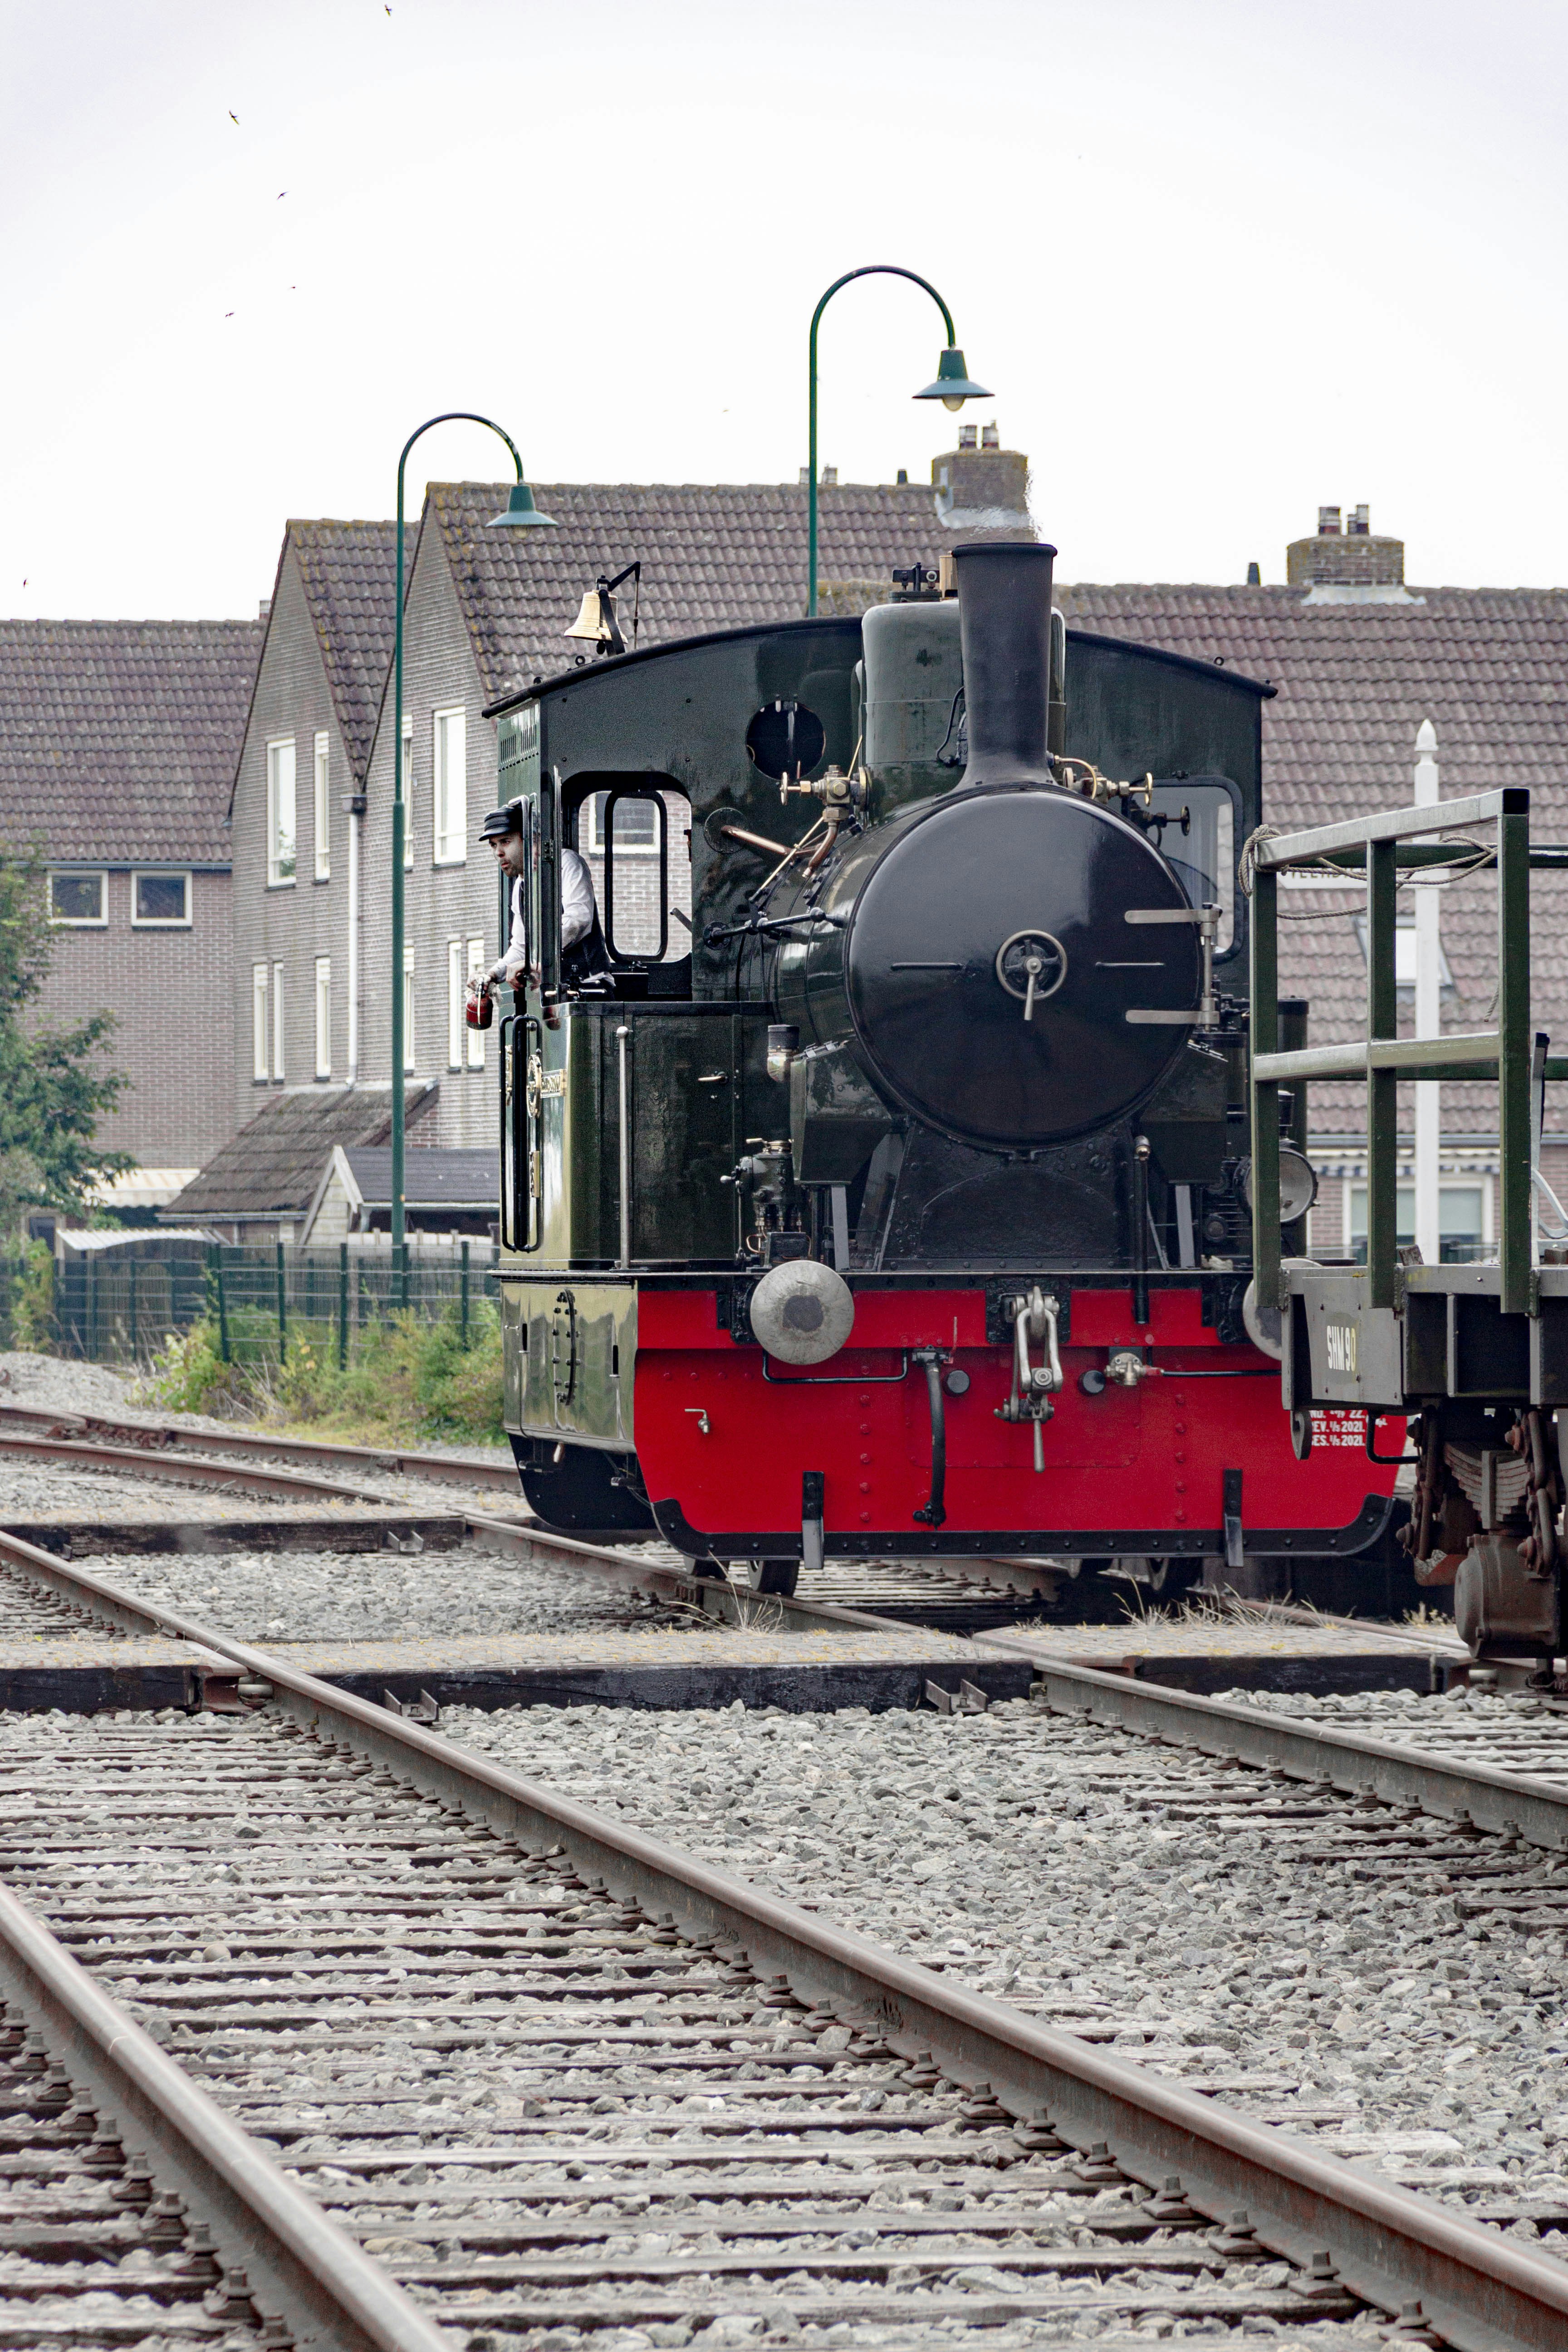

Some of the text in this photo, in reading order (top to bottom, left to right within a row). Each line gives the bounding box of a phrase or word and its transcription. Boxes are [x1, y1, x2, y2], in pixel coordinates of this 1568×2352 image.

[1327, 1325, 1356, 1372] SHM 90
[1311, 1420, 1330, 1432] EV.
[1341, 1420, 1365, 1432] 2021.
[1311, 1434, 1330, 1446] ES.
[1341, 1434, 1365, 1446] 2021.
